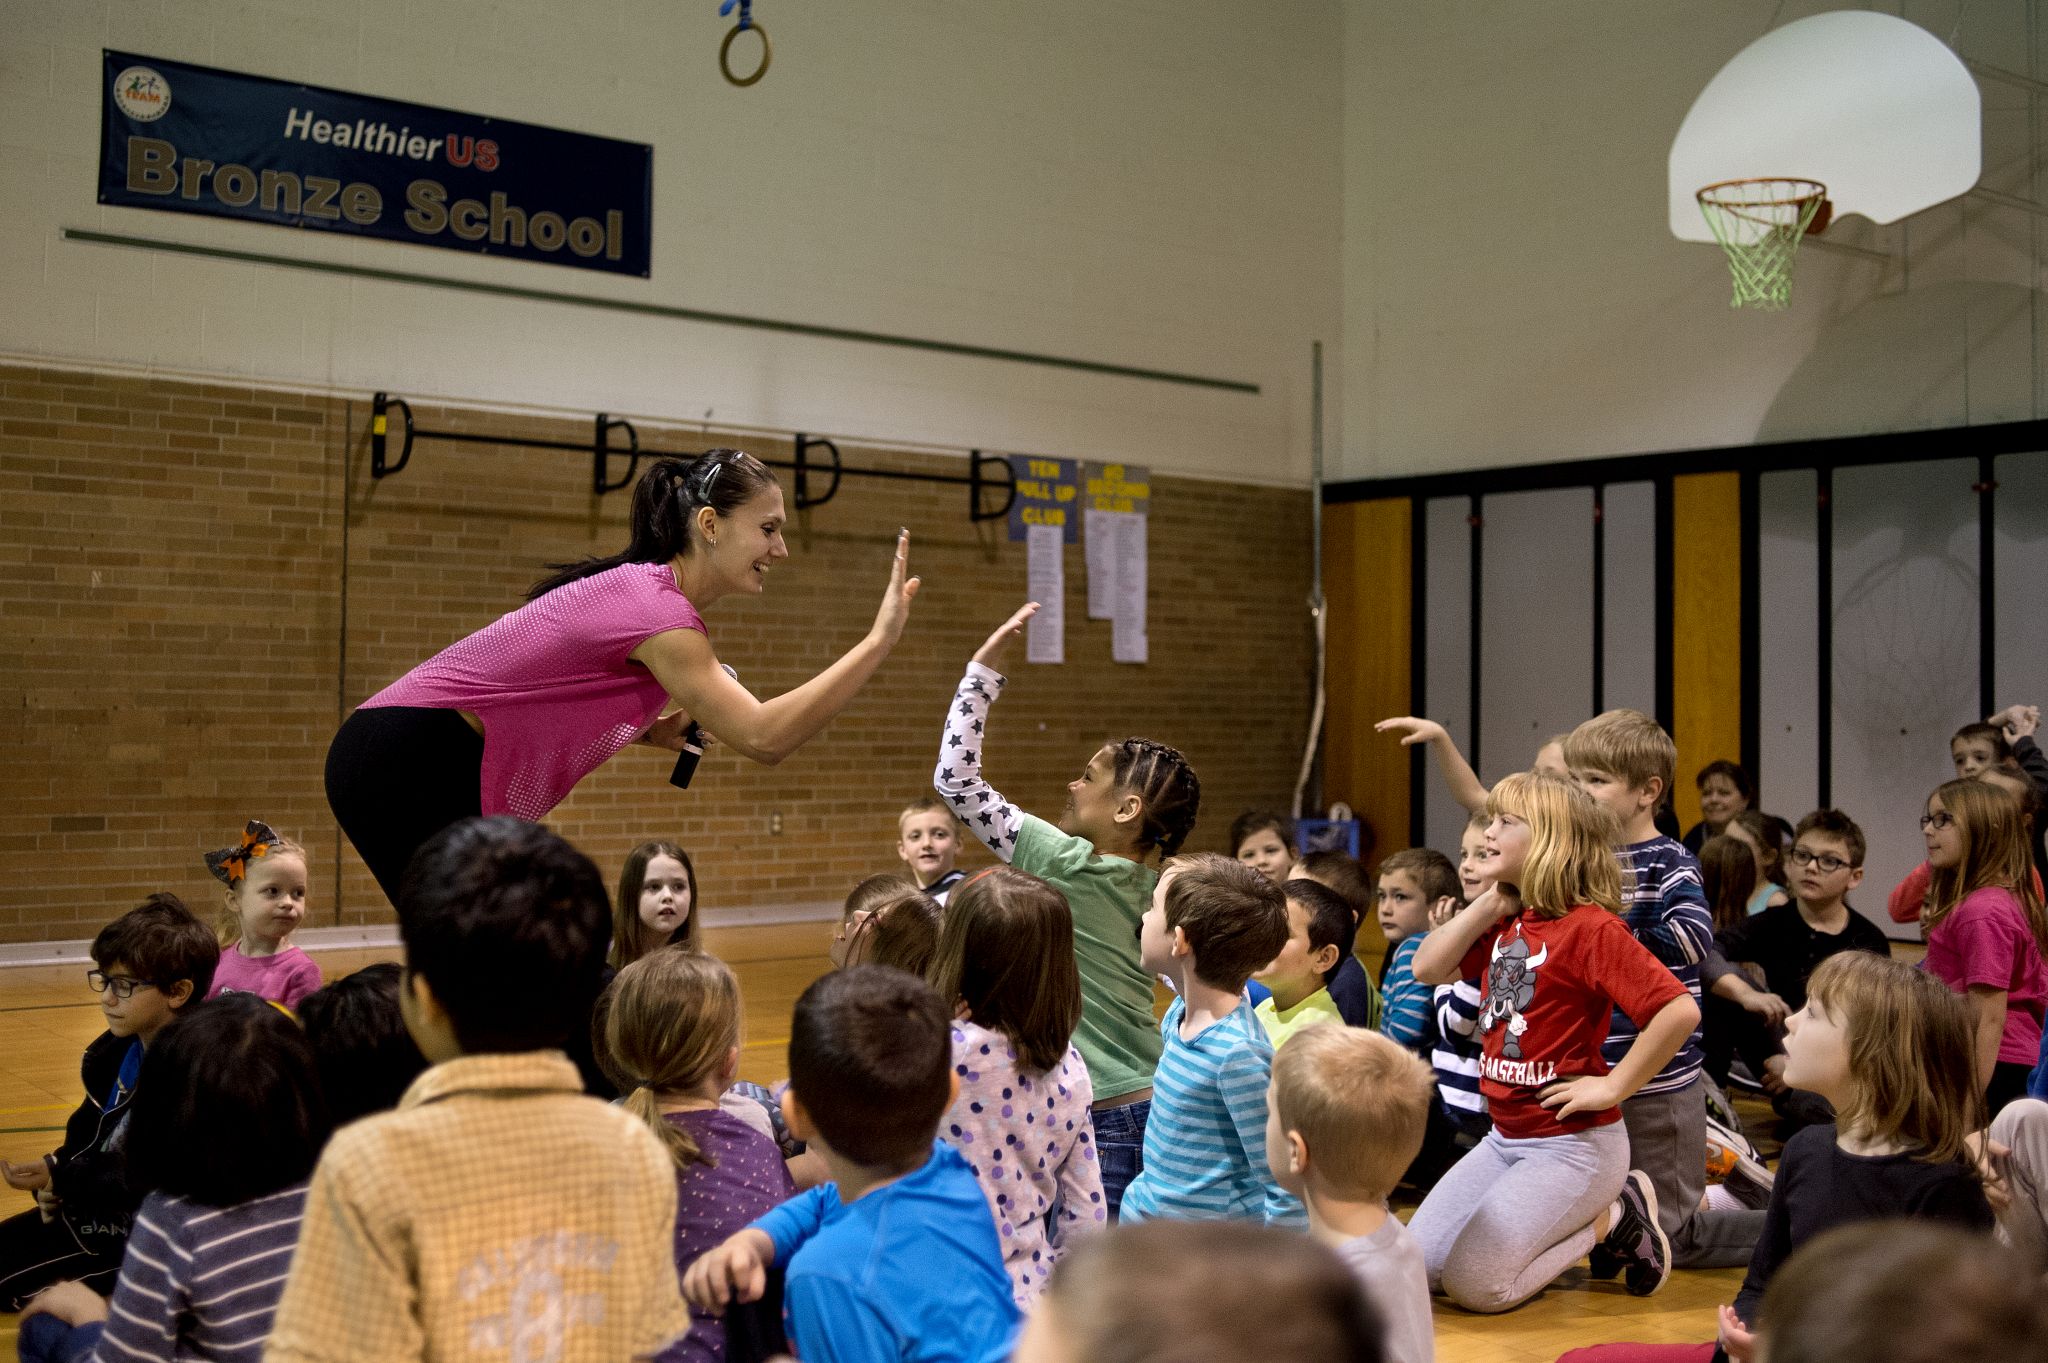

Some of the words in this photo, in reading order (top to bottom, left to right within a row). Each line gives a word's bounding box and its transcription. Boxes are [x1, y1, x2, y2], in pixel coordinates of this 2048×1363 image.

[126, 134, 383, 225] Bronze
[403, 179, 623, 262] School
[1028, 459, 1061, 480] TEN
[1055, 484, 1076, 502] UP
[1021, 506, 1066, 527] CLUB
[1486, 1056, 1557, 1086] BASEBALL
